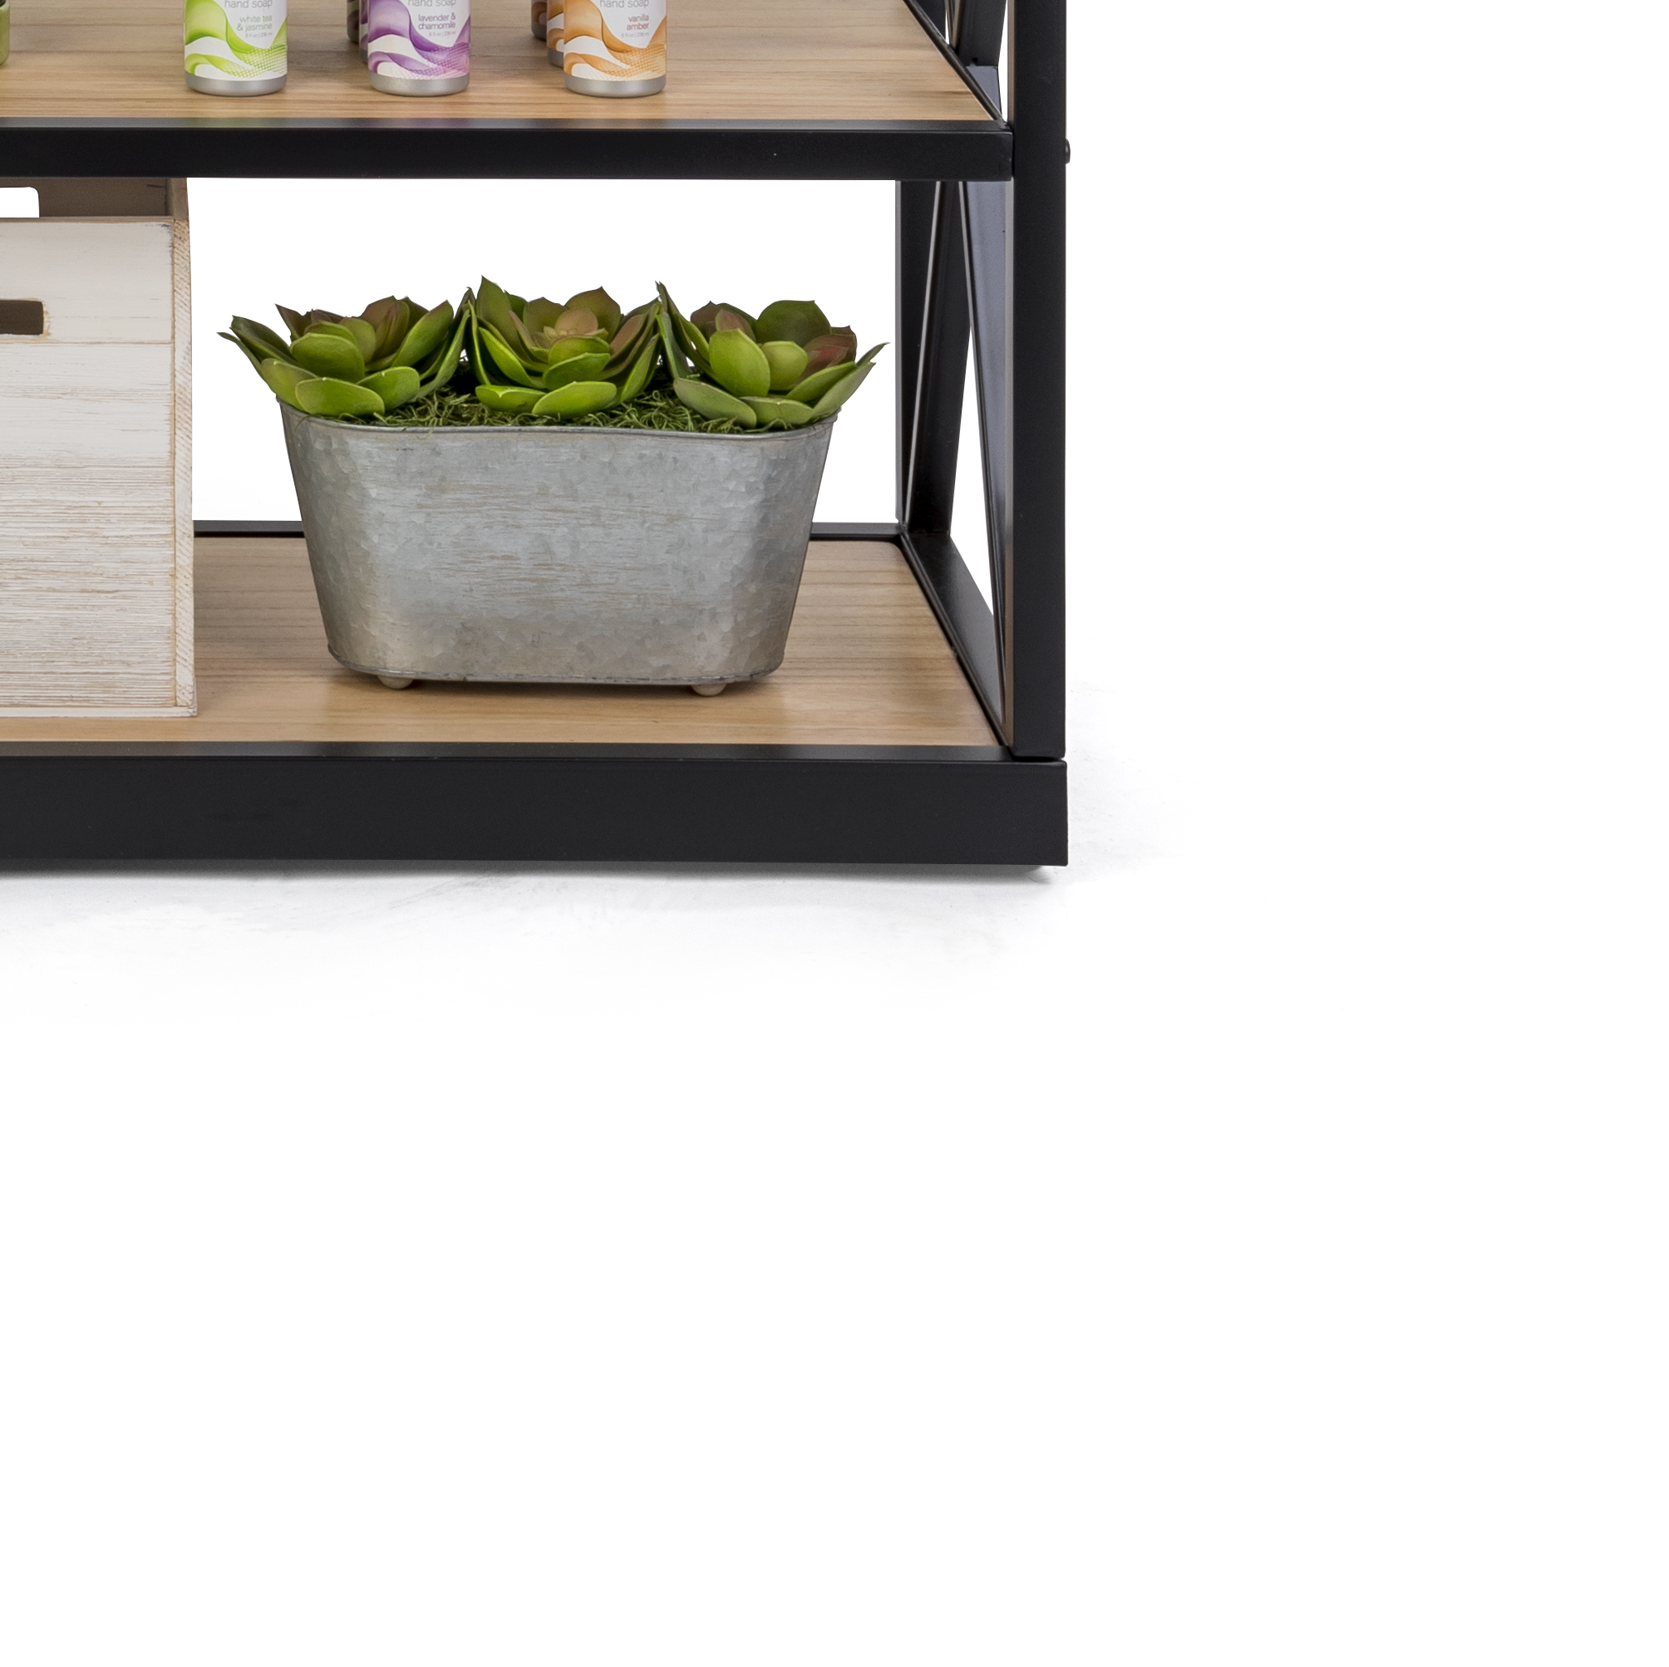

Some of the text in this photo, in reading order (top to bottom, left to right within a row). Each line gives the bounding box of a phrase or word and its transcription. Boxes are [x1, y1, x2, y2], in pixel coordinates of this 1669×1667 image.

[252, 0, 273, 9] soap
[239, 15, 261, 23] white
[418, 13, 450, 22] lavender
[628, 14, 649, 23] vanilla
[236, 23, 273, 32] & jasmine
[418, 21, 457, 30] chamomile
[626, 22, 649, 31] amber
